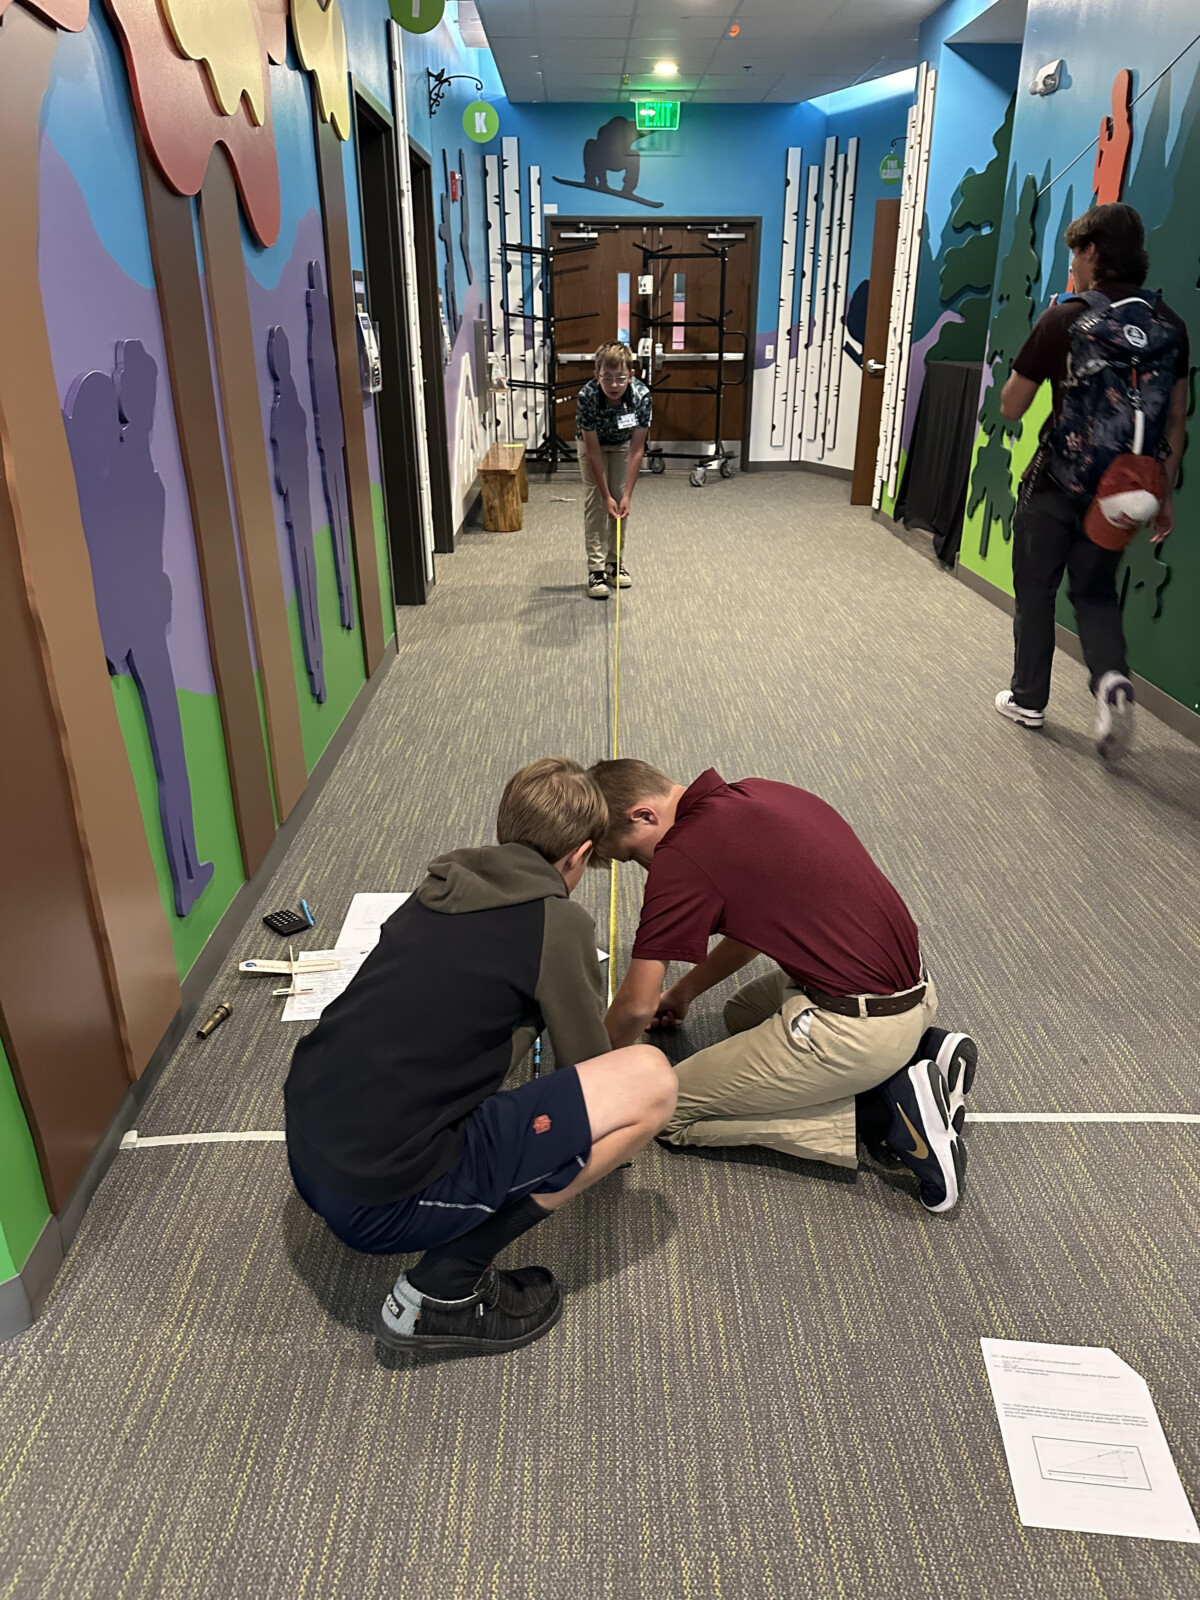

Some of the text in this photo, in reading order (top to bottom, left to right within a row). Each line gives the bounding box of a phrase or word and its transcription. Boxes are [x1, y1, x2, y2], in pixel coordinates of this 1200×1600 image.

[474, 112, 488, 133] K
[645, 103, 672, 126] EXIT
[887, 160, 898, 168] THE
